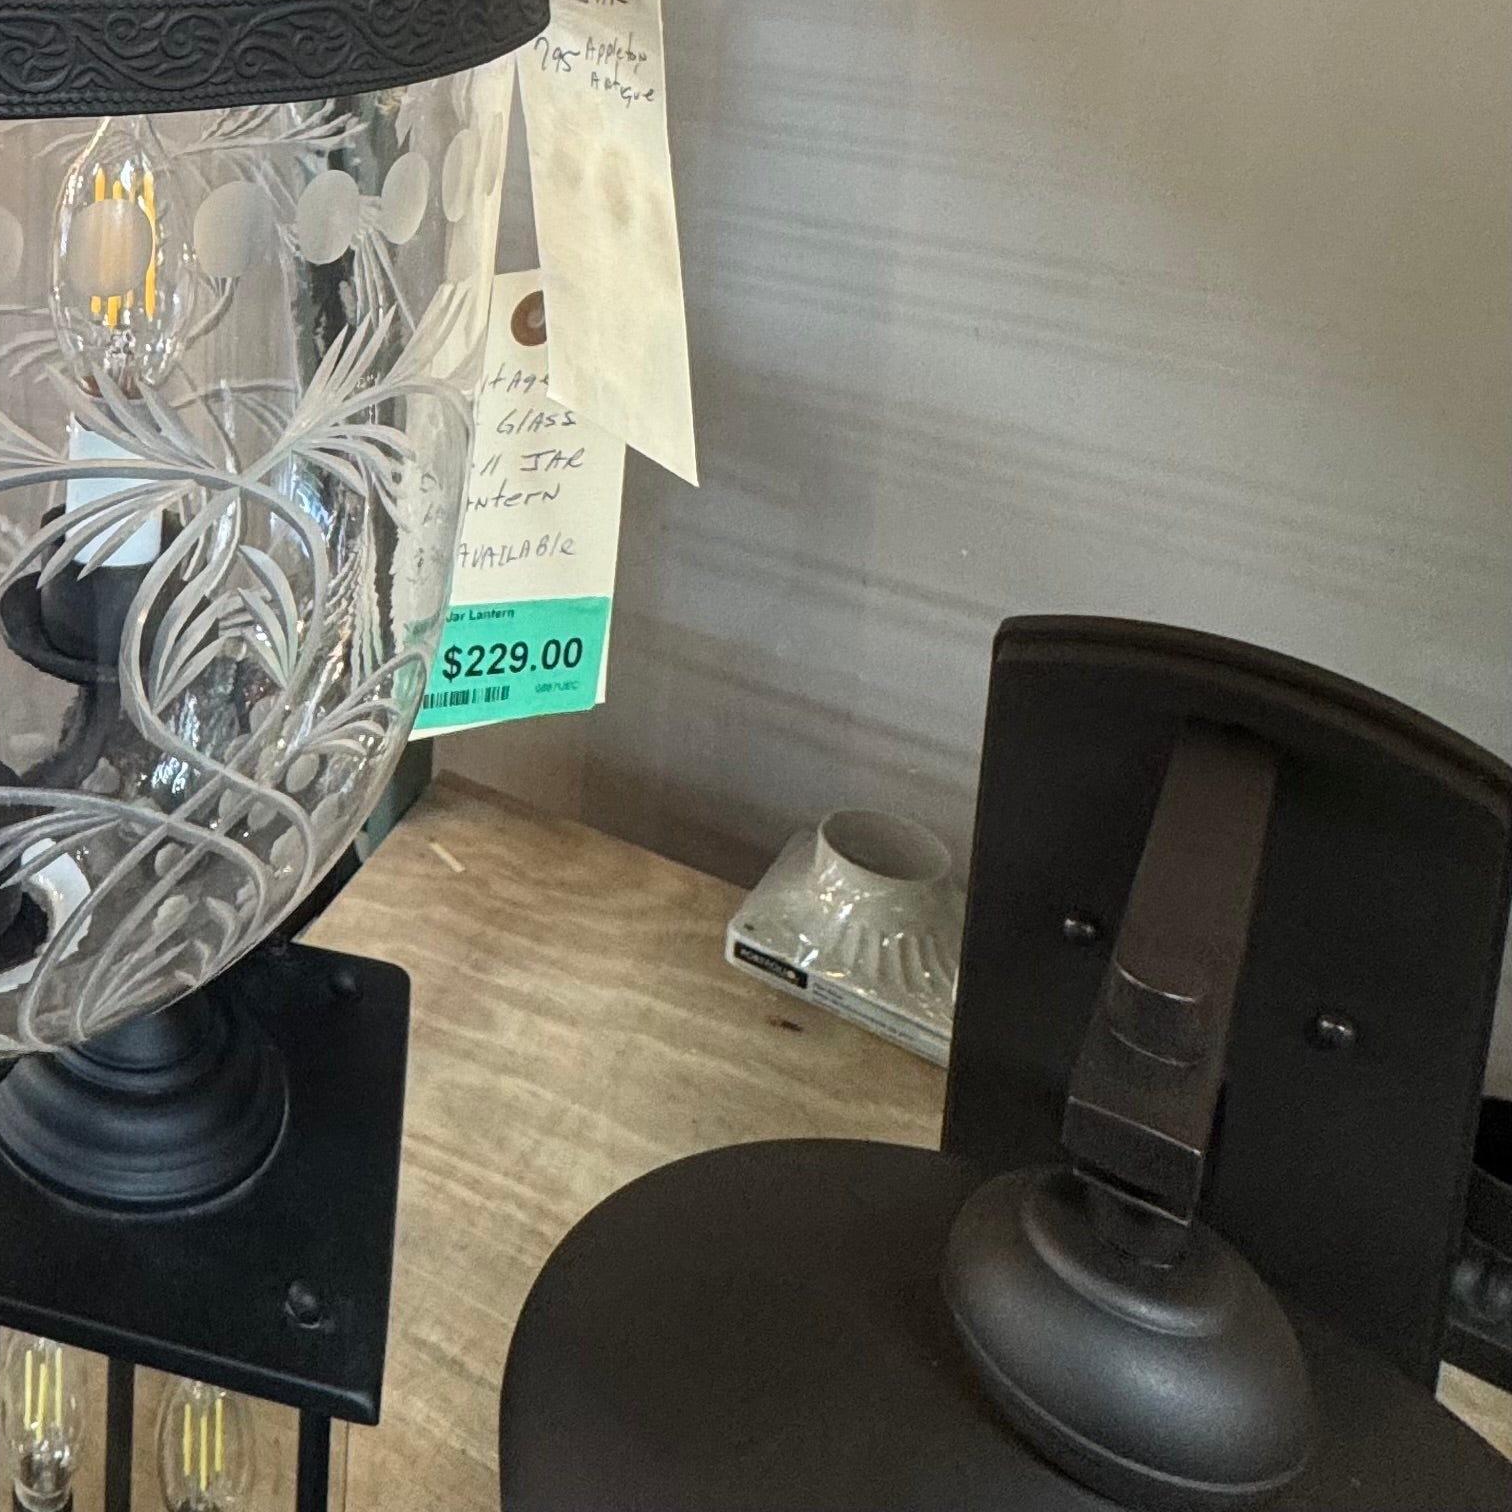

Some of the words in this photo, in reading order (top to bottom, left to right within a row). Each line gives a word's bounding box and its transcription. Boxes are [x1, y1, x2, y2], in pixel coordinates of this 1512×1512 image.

[519, 446, 585, 472] JAR
[468, 608, 515, 621] Lantern
[442, 637, 583, 683] $229.00
